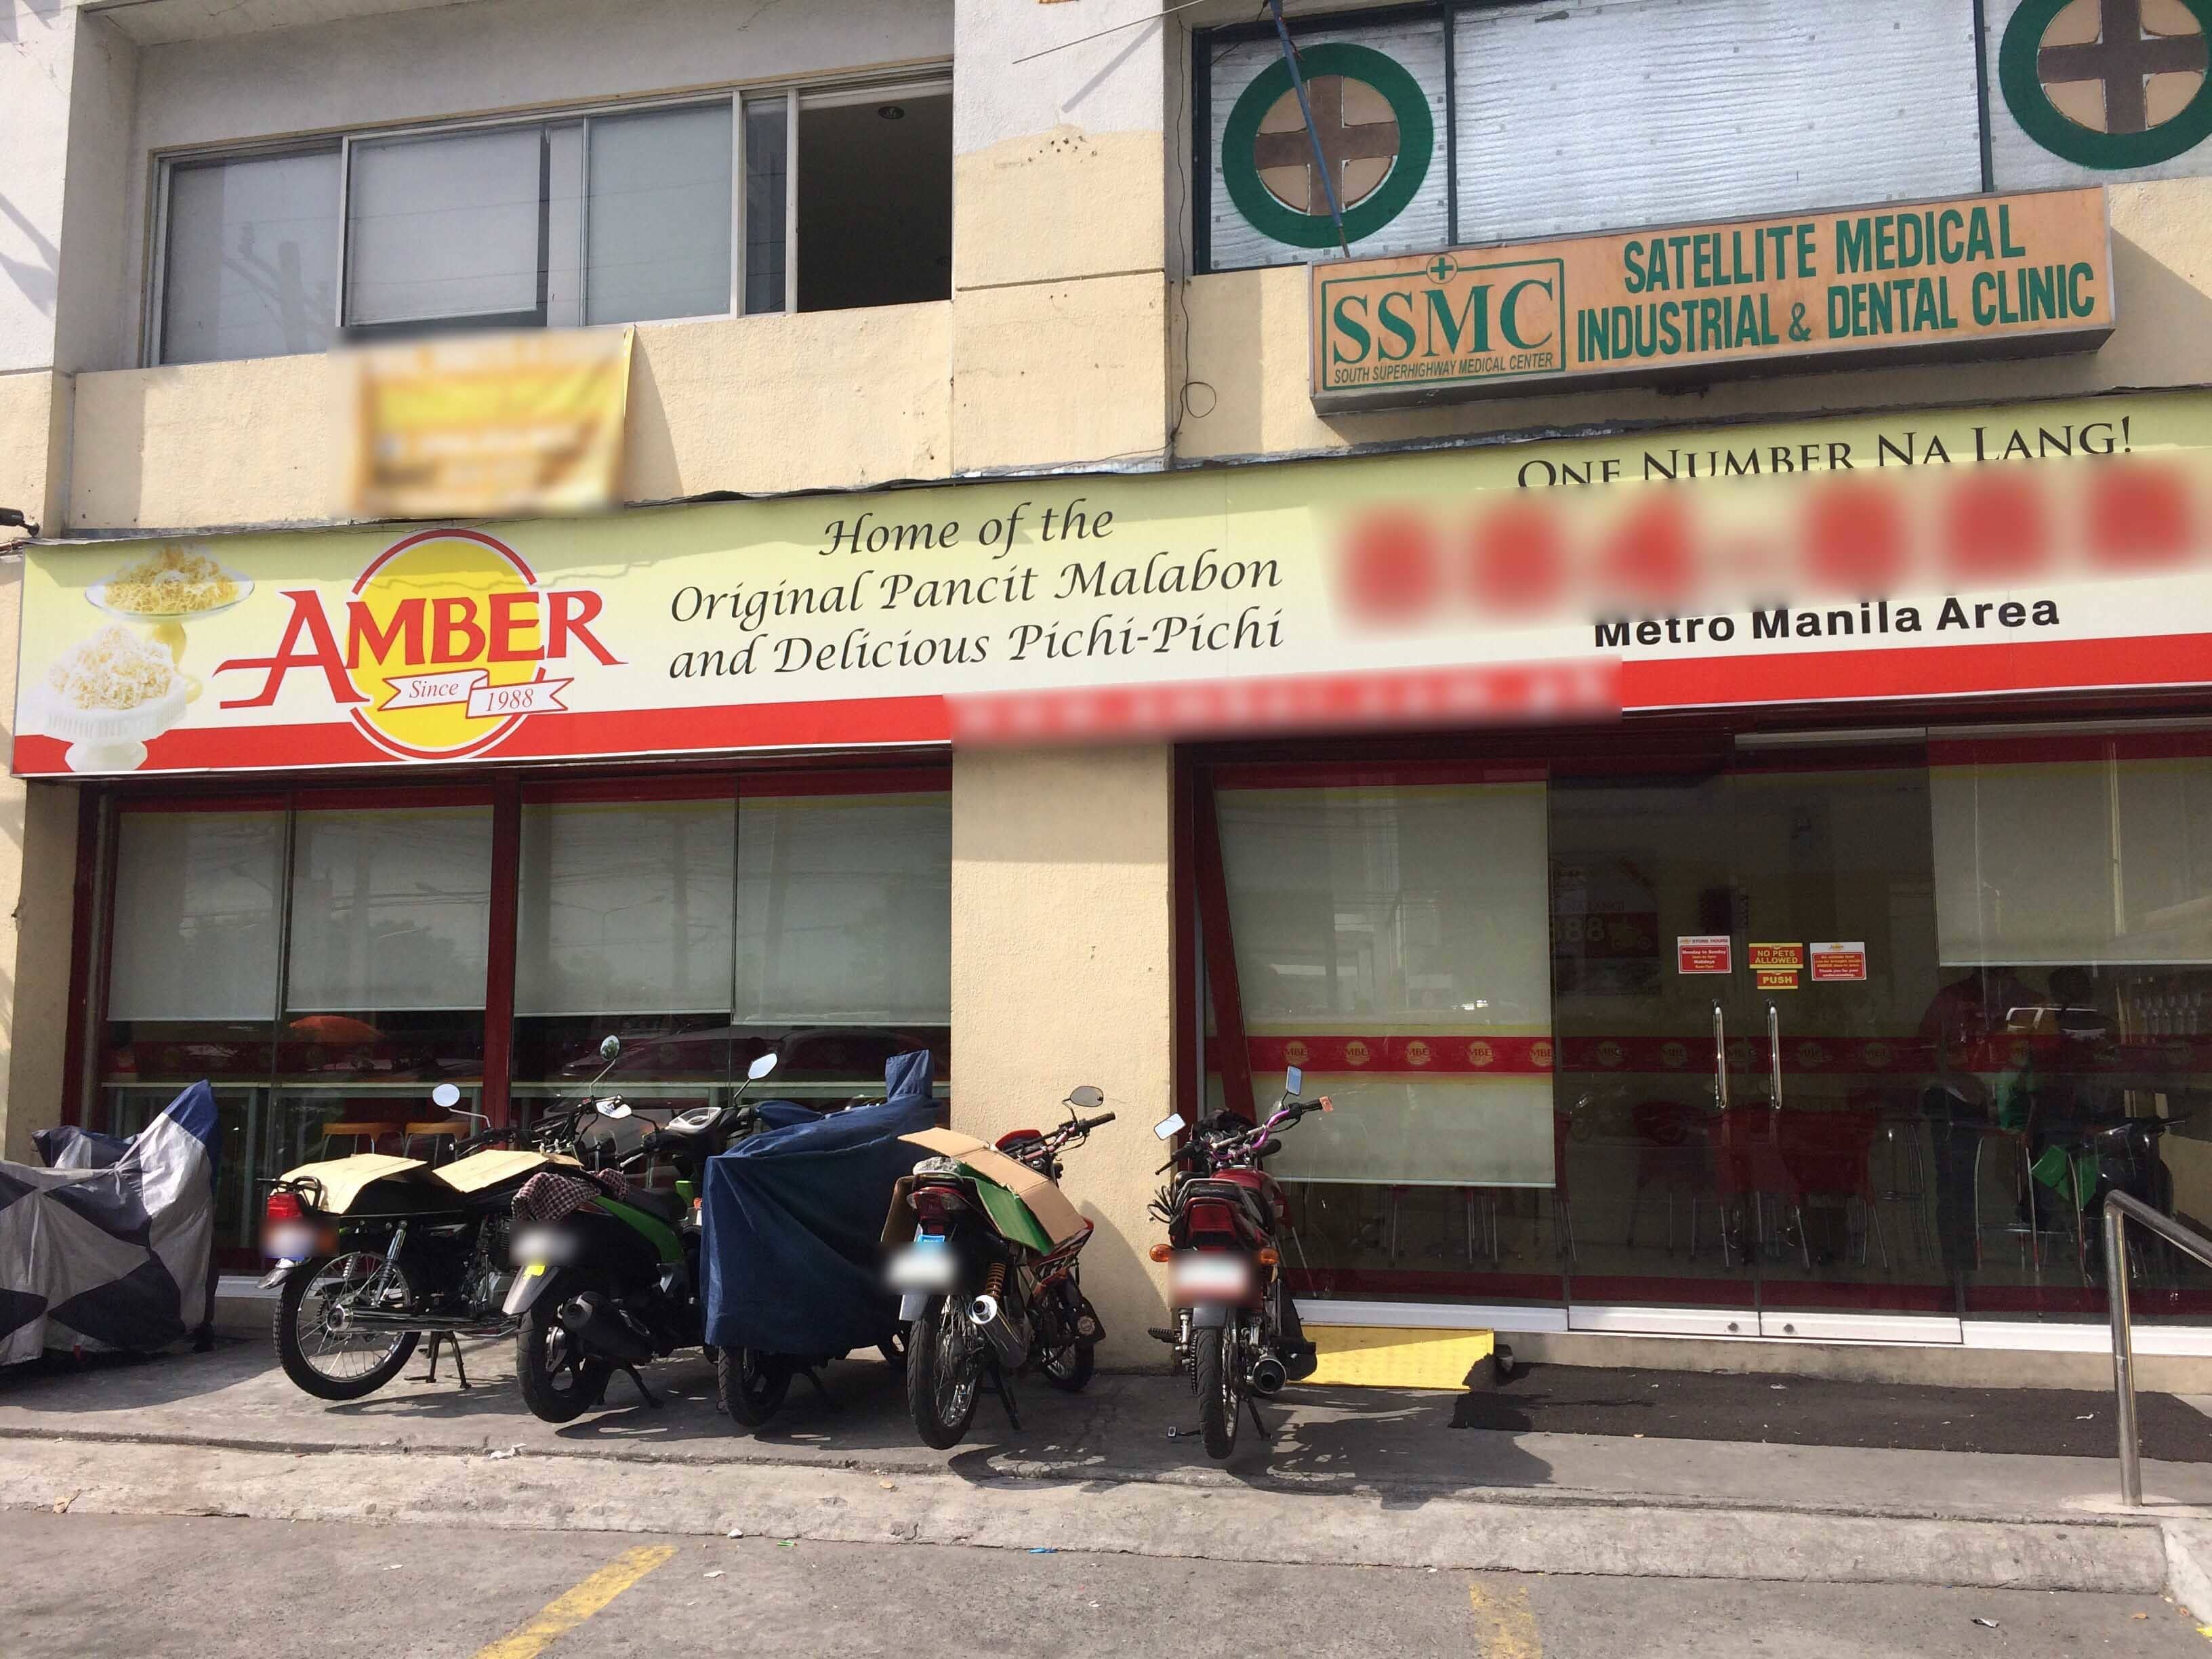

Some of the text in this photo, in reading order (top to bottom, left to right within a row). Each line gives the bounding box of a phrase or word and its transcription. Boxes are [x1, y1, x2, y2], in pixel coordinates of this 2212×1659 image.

[1624, 204, 2026, 294] SATELLITE MEDICAL
[1333, 276, 1553, 366] SSMC
[1577, 262, 2095, 363] INDUSTRIAL & DENTAL CLINIC
[1334, 352, 1553, 384] SOUTH SUPERHIGHWAY MEDICAL CENTER
[1878, 432, 1952, 467] NA
[1971, 415, 2131, 462] LANG!
[818, 497, 1115, 560] Home of the
[671, 548, 1283, 633] Original Pancit Malabon
[1594, 597, 2060, 647] Metro Manila Area
[212, 590, 629, 709] AMBER
[669, 607, 1285, 680] and Delicious Pichi-Pichi
[409, 678, 535, 712] Since 1988
[1762, 976, 1793, 984] PUSH
